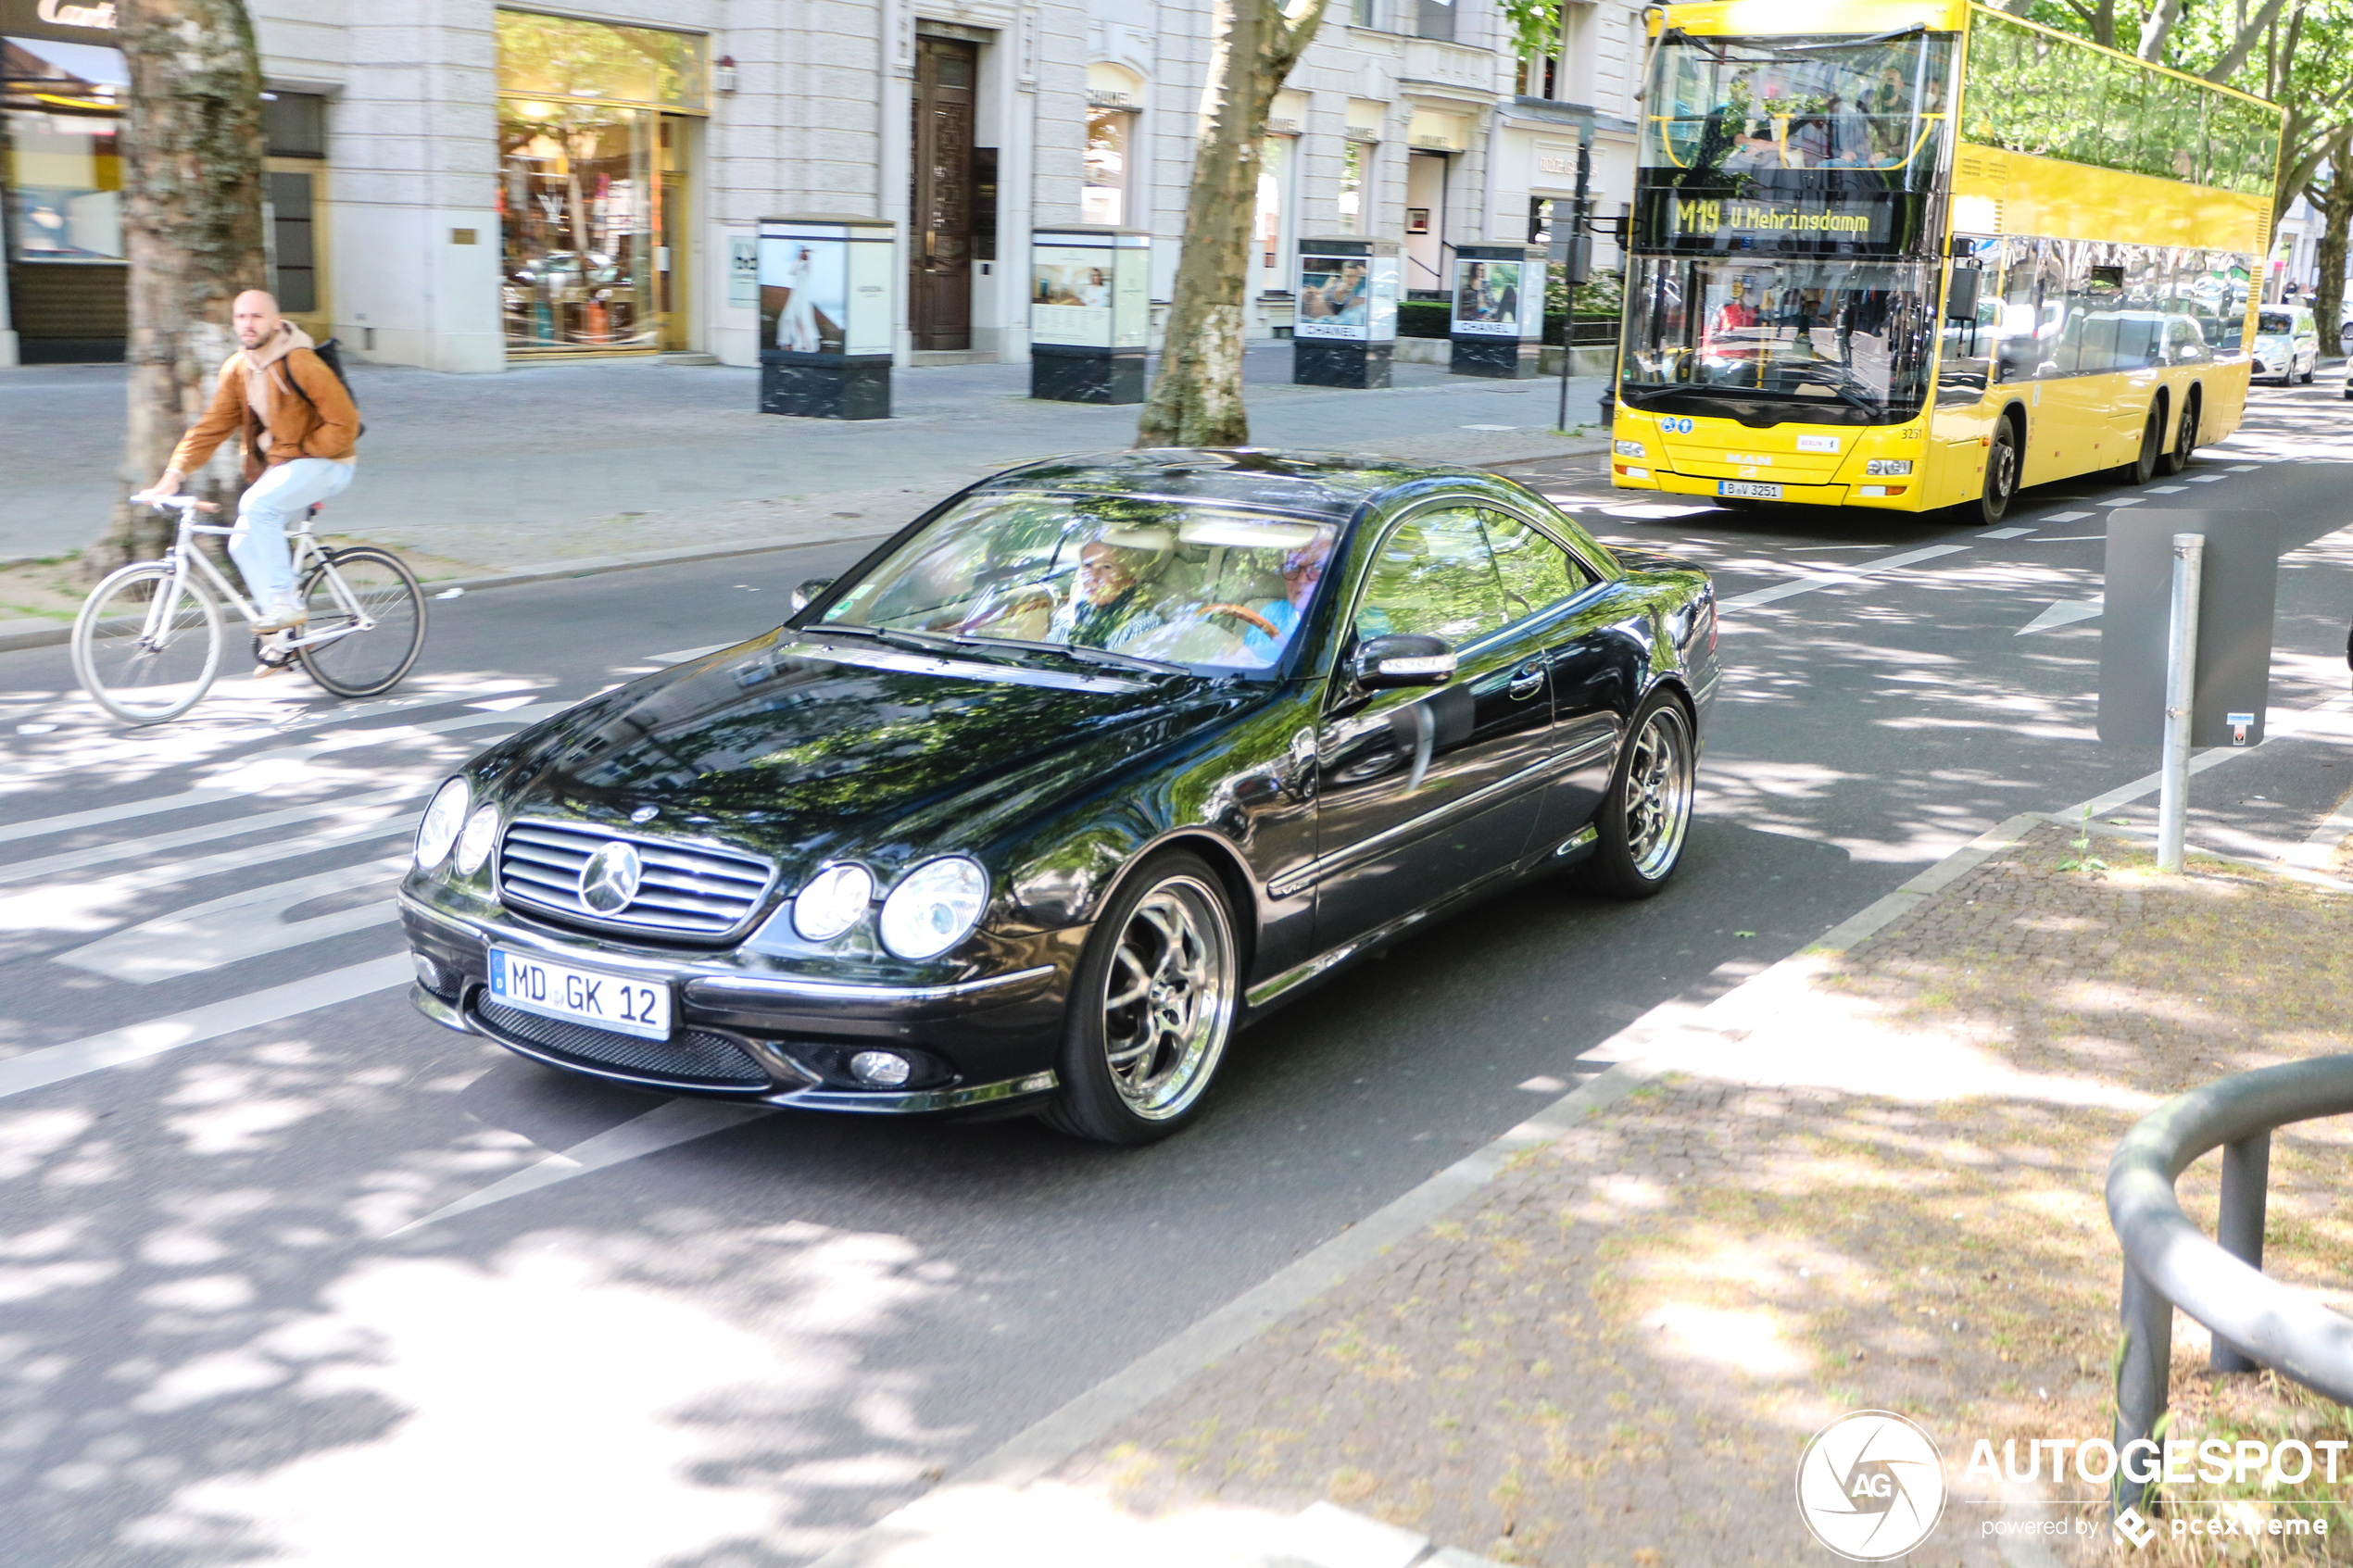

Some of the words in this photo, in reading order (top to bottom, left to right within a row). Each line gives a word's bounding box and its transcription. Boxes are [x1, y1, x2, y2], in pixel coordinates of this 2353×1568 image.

[1675, 199, 1720, 232] M19
[1730, 207, 1743, 229] U
[1746, 207, 1869, 232] Mehringdamm
[1304, 325, 1358, 337] CHANEL
[1461, 322, 1508, 333] CHANEL
[1901, 429, 1922, 440] 3251
[1726, 453, 1772, 466] MAN
[1728, 483, 1735, 494] B
[1742, 484, 1749, 495] V
[1751, 484, 1777, 496] 3251
[512, 961, 546, 1001] MD
[567, 974, 604, 1015] GK
[620, 985, 657, 1025] 12
